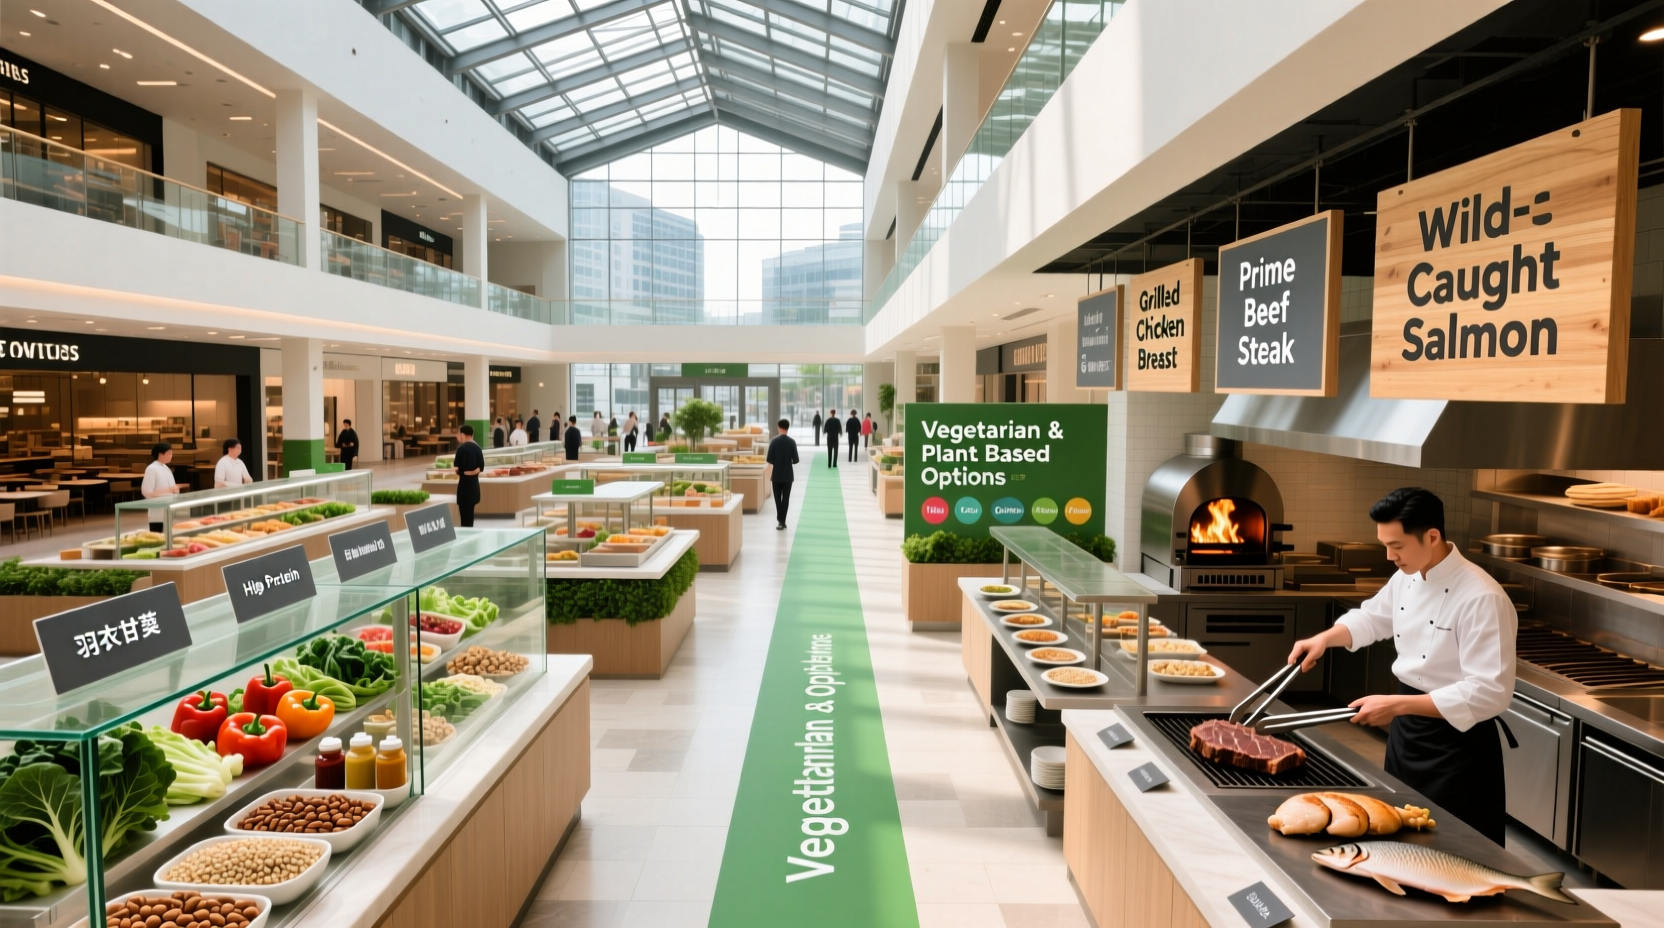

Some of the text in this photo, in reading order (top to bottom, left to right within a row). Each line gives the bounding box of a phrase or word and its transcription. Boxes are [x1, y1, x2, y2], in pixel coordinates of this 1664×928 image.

[1240, 257, 1296, 291] Prime
[1407, 242, 1560, 311] Caught
[1139, 280, 1180, 312] Grilled
[1244, 290, 1290, 327] Beef
[1136, 314, 1184, 341] Chicken
[1402, 313, 1558, 361] Salmon
[1138, 347, 1178, 370] Breast
[1238, 331, 1295, 365] Steak
[921, 420, 1064, 444] Vegetarian &
[922, 444, 1050, 463] Plant Based
[921, 466, 1006, 490] Options
[805, 700, 835, 713] &
